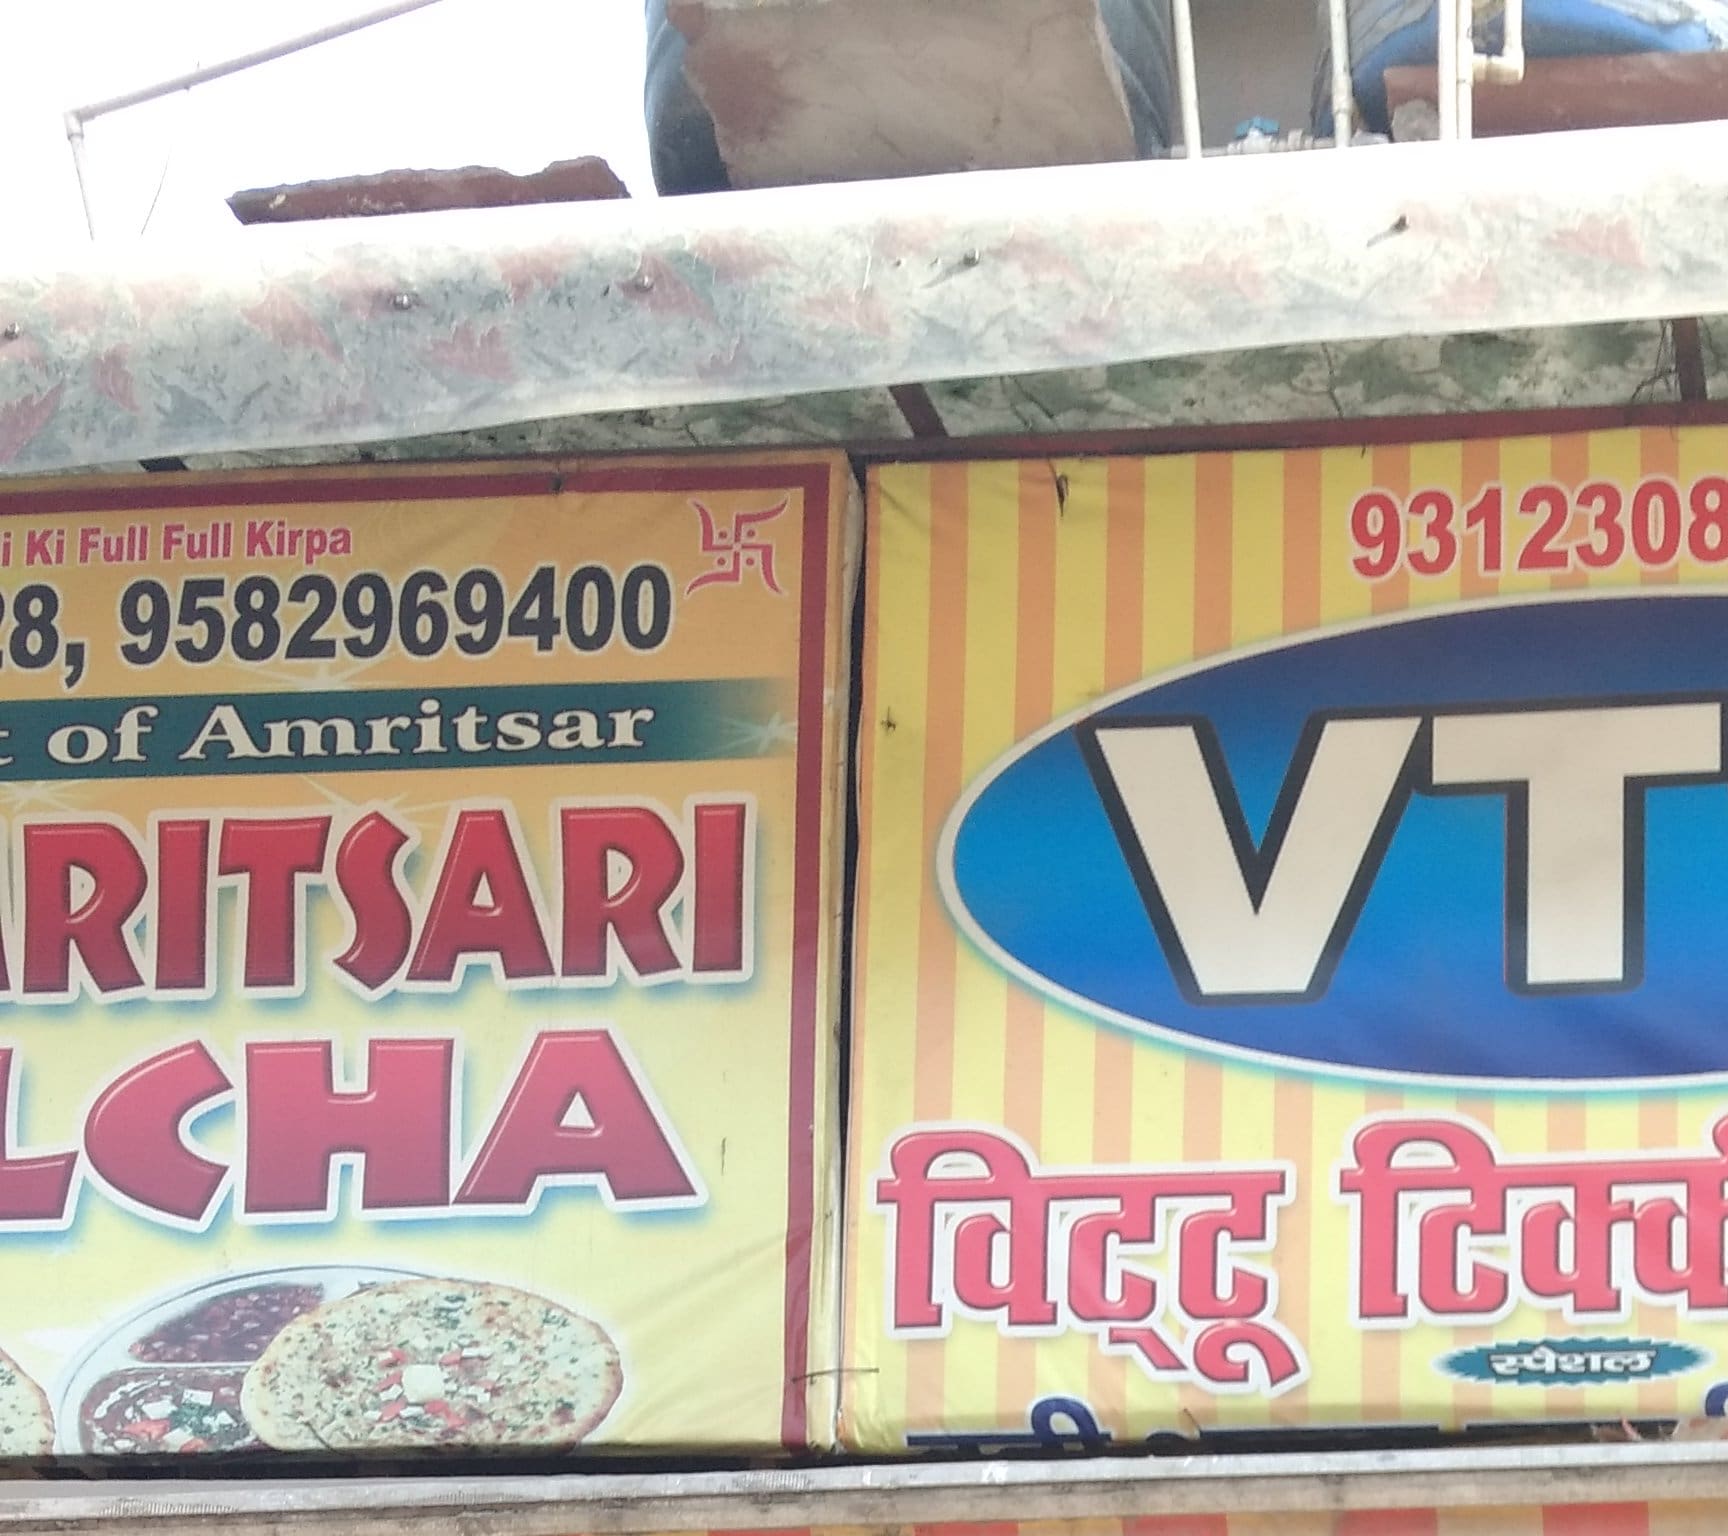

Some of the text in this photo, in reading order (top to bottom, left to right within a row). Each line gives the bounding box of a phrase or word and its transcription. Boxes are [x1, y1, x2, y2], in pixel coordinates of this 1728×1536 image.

[26, 529, 65, 567] Ki
[79, 525, 149, 564] Full
[163, 522, 232, 561] Full
[247, 520, 352, 566] Kirpa
[0, 565, 673, 690] 8, 9582969400
[47, 704, 159, 765] of
[178, 700, 655, 761] Amritsar
[0, 805, 748, 994] RITSARI
[1490, 1345, 1656, 1375] स्पेशल
